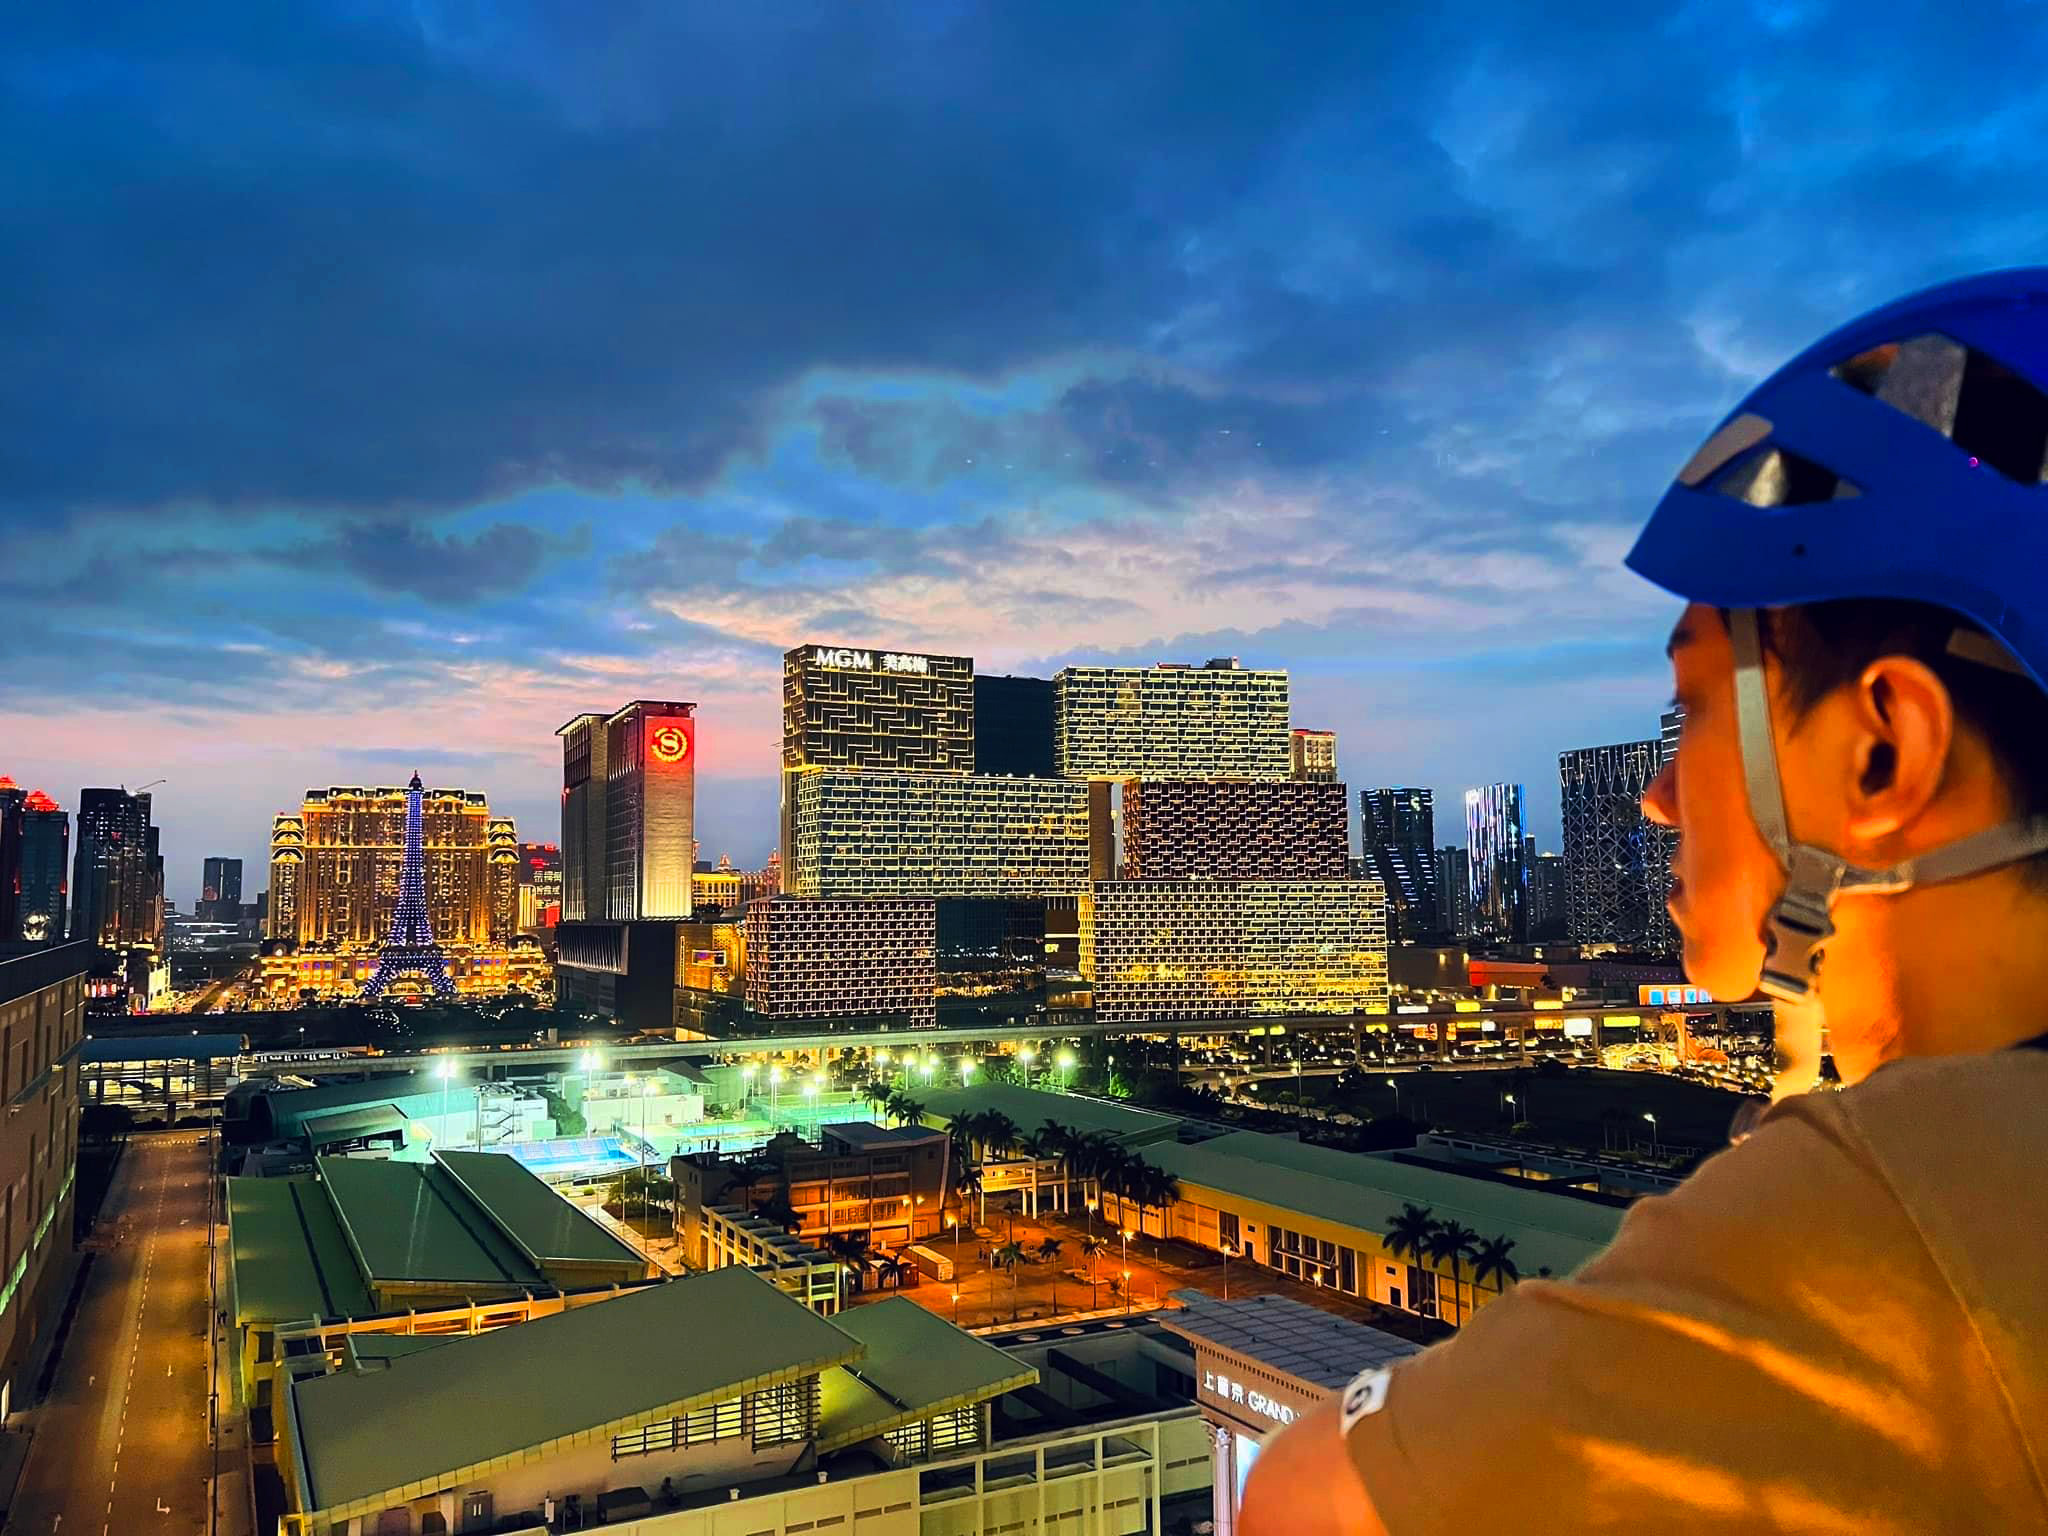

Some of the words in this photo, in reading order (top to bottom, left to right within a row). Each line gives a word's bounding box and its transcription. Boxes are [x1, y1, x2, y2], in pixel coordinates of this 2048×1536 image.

[815, 649, 871, 669] MGM
[881, 653, 928, 672] 美高梅
[1247, 1391, 1293, 1424] GRAND
